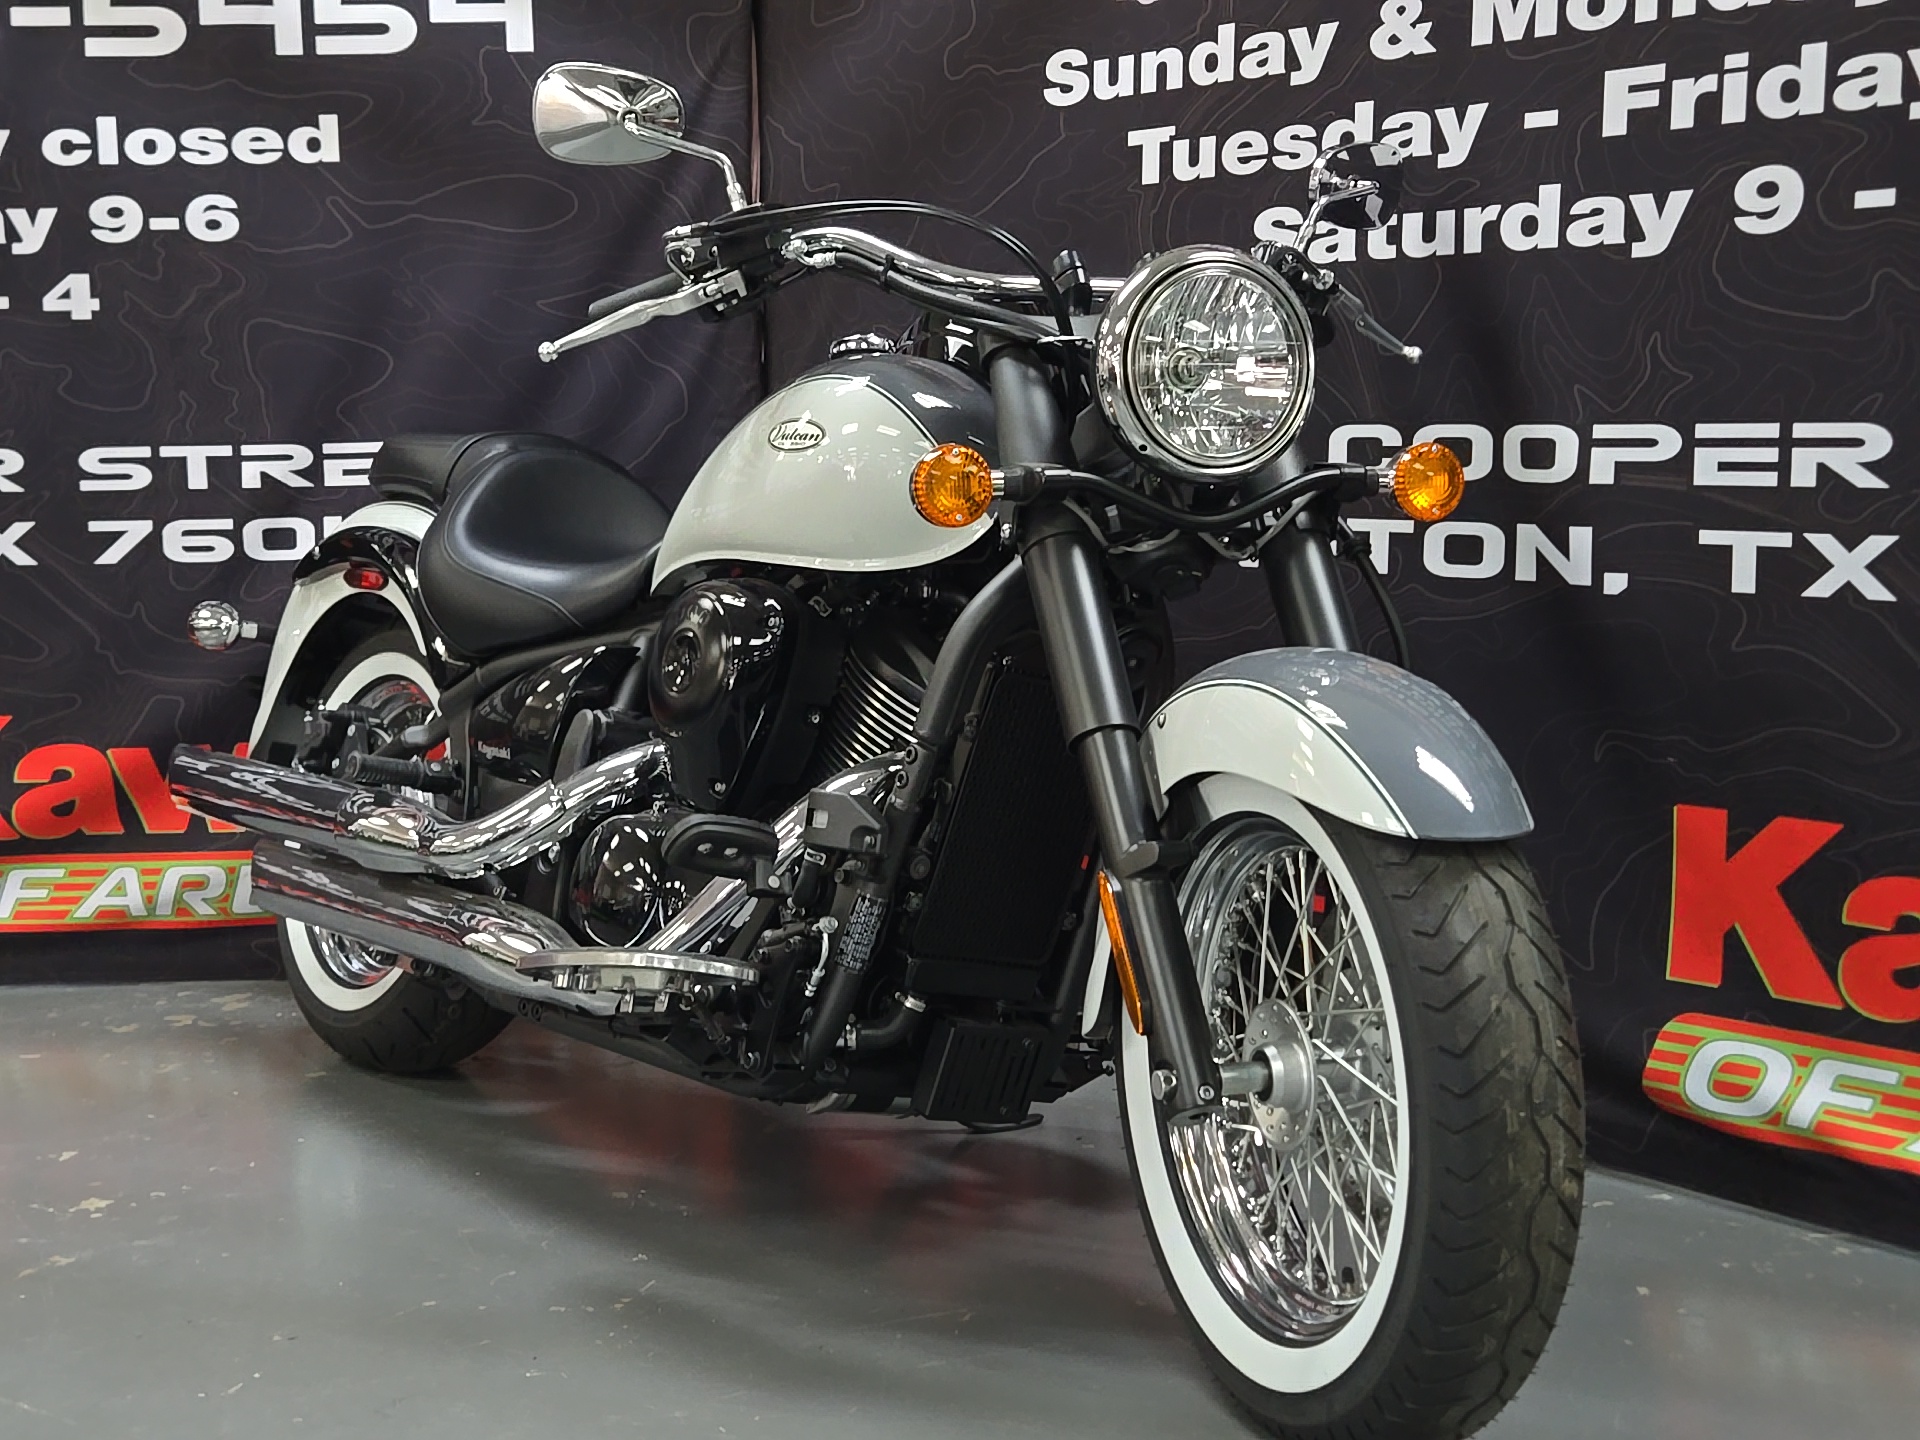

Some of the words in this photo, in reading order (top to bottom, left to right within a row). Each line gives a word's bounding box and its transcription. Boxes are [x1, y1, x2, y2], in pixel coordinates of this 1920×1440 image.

[1044, 22, 1340, 107] Sunday
[1370, 0, 1437, 60] &
[42, 114, 340, 167] closed
[1128, 100, 1489, 186] Tuesday
[1602, 42, 1920, 138] Frida
[89, 194, 240, 244] 9-6
[1253, 183, 1694, 264] Saturday
[1734, 165, 1805, 235] 9
[43, 274, 100, 320] 4
[771, 424, 821, 443] Vulcan
[88, 516, 345, 566] 760
[1699, 530, 1900, 602] TX
[1684, 1039, 1901, 1129] OF
